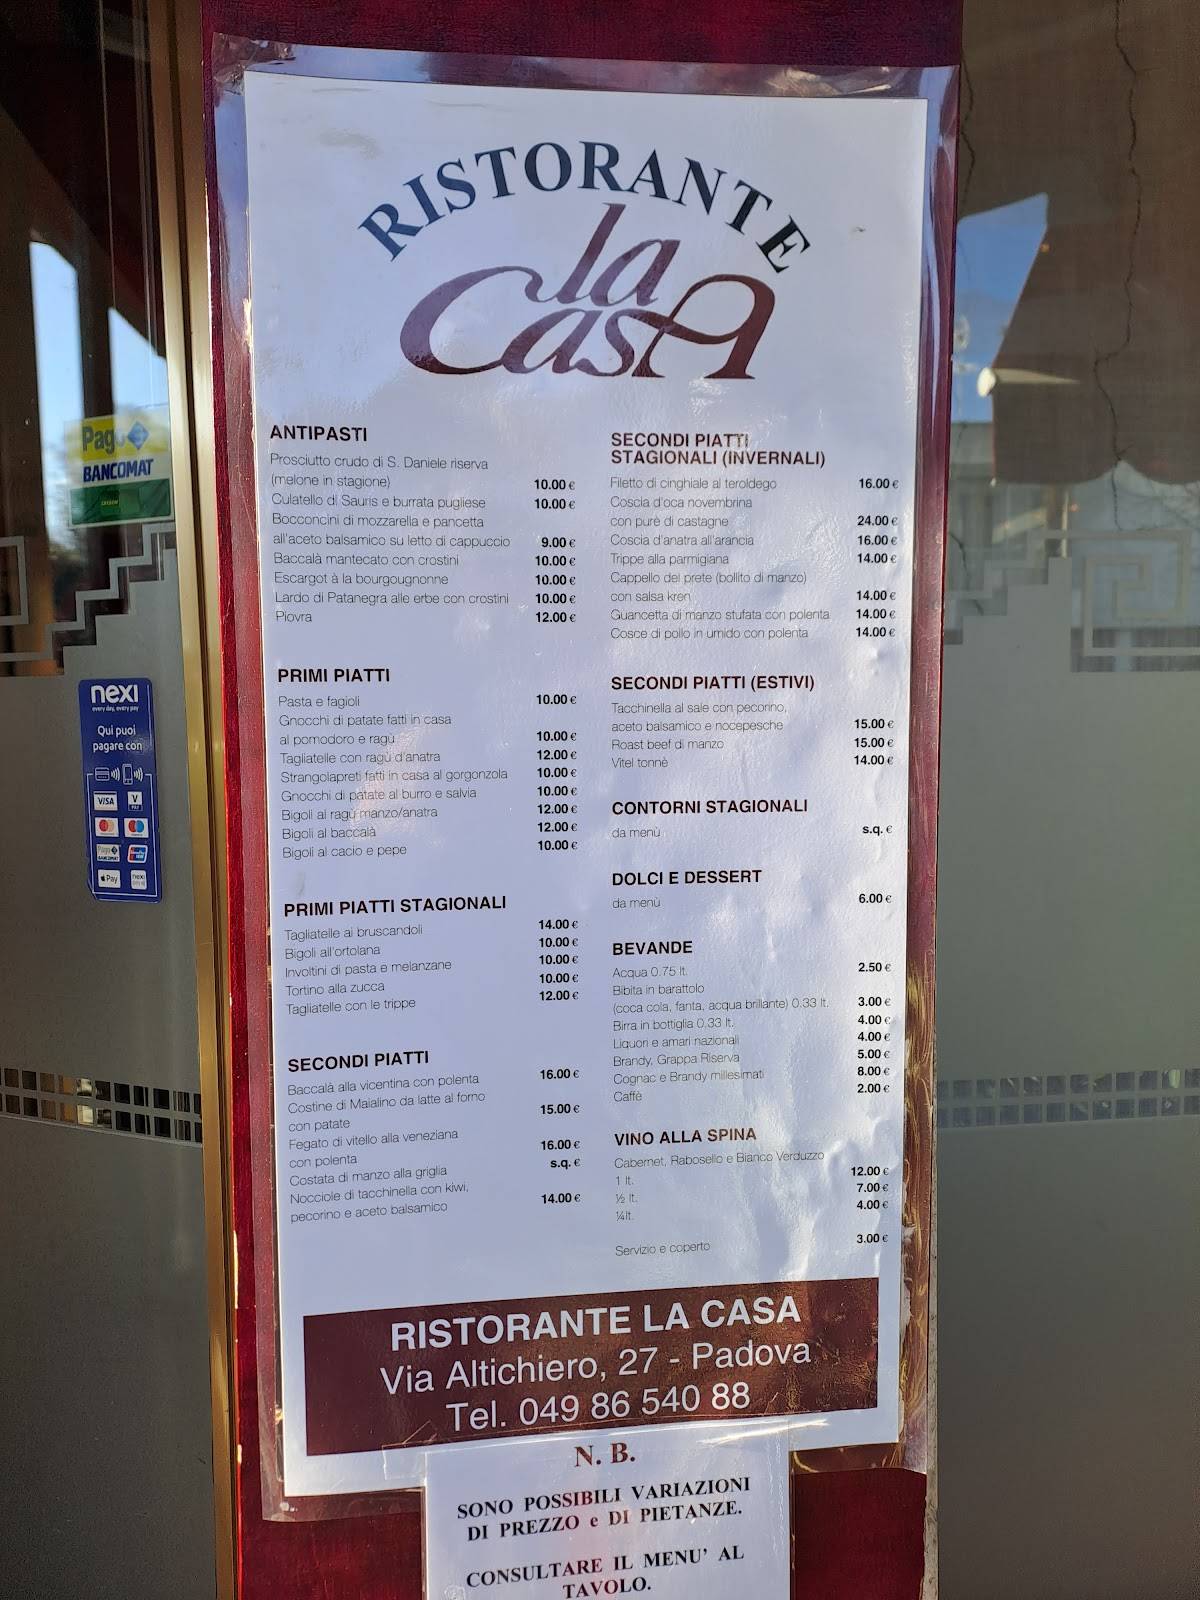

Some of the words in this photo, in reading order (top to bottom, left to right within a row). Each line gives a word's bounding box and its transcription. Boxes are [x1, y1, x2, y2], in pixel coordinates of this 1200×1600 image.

[358, 140, 810, 273] RISTORANTE
[270, 425, 367, 441] ANTIPASTI
[612, 433, 689, 447] SECONDI
[696, 434, 748, 447] PIATTI
[271, 453, 330, 466] Prosciutto
[335, 456, 369, 467] crudo
[373, 456, 383, 467] di
[388, 456, 399, 468] S.
[404, 457, 447, 468] Daniele
[451, 458, 488, 469] riserva
[612, 450, 716, 464] STAGIONALI
[723, 451, 825, 468] (INVERNALI)
[83, 459, 153, 482] BANCOMAT
[611, 477, 643, 488] Filetto
[647, 477, 656, 488] di
[660, 478, 708, 491] cinghiale
[713, 478, 721, 488] al
[725, 478, 777, 491] teroldego
[274, 552, 322, 564] Baccalà
[326, 554, 388, 566] mantecato
[392, 557, 414, 565] con
[418, 554, 458, 566] crostini
[610, 553, 644, 566] Trippe
[648, 554, 665, 564] alla
[670, 554, 729, 566] parmigiana
[275, 572, 327, 586] Escargot
[343, 573, 352, 584] la
[276, 611, 312, 622] Piovra
[278, 669, 327, 682] PRIMI
[334, 669, 389, 682] PIATTI
[612, 676, 687, 690] SECONDI
[694, 676, 745, 689] PIATTI
[751, 675, 814, 692] (ESTIVI)
[91, 685, 138, 703] nexi
[279, 696, 312, 707] Pasta
[316, 699, 323, 707] e
[328, 696, 359, 709] fagioli
[98, 725, 113, 737] Qui
[116, 725, 136, 737] puoi
[93, 742, 123, 753] pagare
[612, 758, 633, 768] Vitel
[98, 797, 114, 805] VISA
[612, 801, 700, 815] CONTORNI
[706, 799, 807, 813] STAGIONALI
[612, 828, 626, 838] da
[630, 827, 660, 838] menù
[106, 875, 117, 884] Pay
[613, 872, 663, 885] DOLCI
[669, 872, 679, 884] E
[685, 870, 762, 884] DESSERT
[285, 902, 333, 917] PRIMI
[340, 900, 394, 914] PIATTI
[401, 896, 505, 912] STAGIONALI
[613, 898, 626, 908] da
[630, 897, 660, 907] menù
[284, 928, 340, 942] Tagliatelle
[344, 927, 353, 937] ai
[357, 925, 422, 937] bruscandoli
[613, 941, 692, 955] BEVANDE
[286, 967, 326, 978] Involtini
[331, 965, 340, 975] di
[345, 964, 376, 976] pasta
[380, 964, 387, 972] e
[392, 962, 451, 972] melanzane
[285, 986, 324, 996] Tortino
[328, 983, 346, 993] alla
[351, 983, 384, 992] zucca
[613, 985, 642, 995] Bibita
[646, 985, 654, 994] in
[659, 983, 704, 994] barattolo
[288, 1054, 368, 1072] SECONDI
[375, 1051, 428, 1066] PIATTI
[338, 1082, 356, 1092] alla
[360, 1078, 410, 1090] vicentina
[413, 1078, 434, 1087] con
[438, 1074, 479, 1088] polenta
[614, 1091, 642, 1102] Caffè
[615, 1132, 654, 1146] VINO
[660, 1130, 702, 1144] ALLA
[708, 1128, 756, 1142] SPINA
[615, 1157, 666, 1168] Cabernet,
[737, 1153, 773, 1162] Bianco
[776, 1150, 824, 1161] Verduzzo
[290, 1174, 335, 1186] Costata
[339, 1172, 348, 1182] di
[352, 1171, 390, 1181] manzo
[394, 1168, 412, 1179] alla
[416, 1166, 447, 1179] griglia
[616, 1245, 656, 1256] Servizio
[670, 1242, 710, 1254] coperto
[390, 1306, 632, 1352] RISTORANTE
[643, 1301, 689, 1331] LA
[701, 1296, 802, 1327] CASA
[380, 1366, 434, 1395] Via
[445, 1351, 606, 1389] Altichiero,
[618, 1347, 659, 1376] 27
[692, 1338, 811, 1369] Padova
[446, 1402, 506, 1432] Tel.
[519, 1394, 579, 1425] 049
[590, 1391, 630, 1419] 86
[642, 1386, 700, 1415] 540
[711, 1381, 751, 1410] 88
[574, 1445, 602, 1467] N.
[610, 1442, 635, 1465] B.
[457, 1498, 514, 1519] SONO
[524, 1487, 622, 1514] POSSIBILI
[631, 1476, 751, 1501] VARIAZIONI
[466, 1523, 488, 1542] DI
[500, 1515, 580, 1538] PREZZO
[590, 1517, 599, 1527] e
[608, 1508, 629, 1526] DI
[640, 1499, 742, 1524] PIETANZE.
[466, 1558, 603, 1588] CONSULTARE
[613, 1555, 633, 1572] IL
[644, 1548, 708, 1568] MENU'
[718, 1544, 745, 1561] AL
[563, 1576, 651, 1600] TAVOLO.
